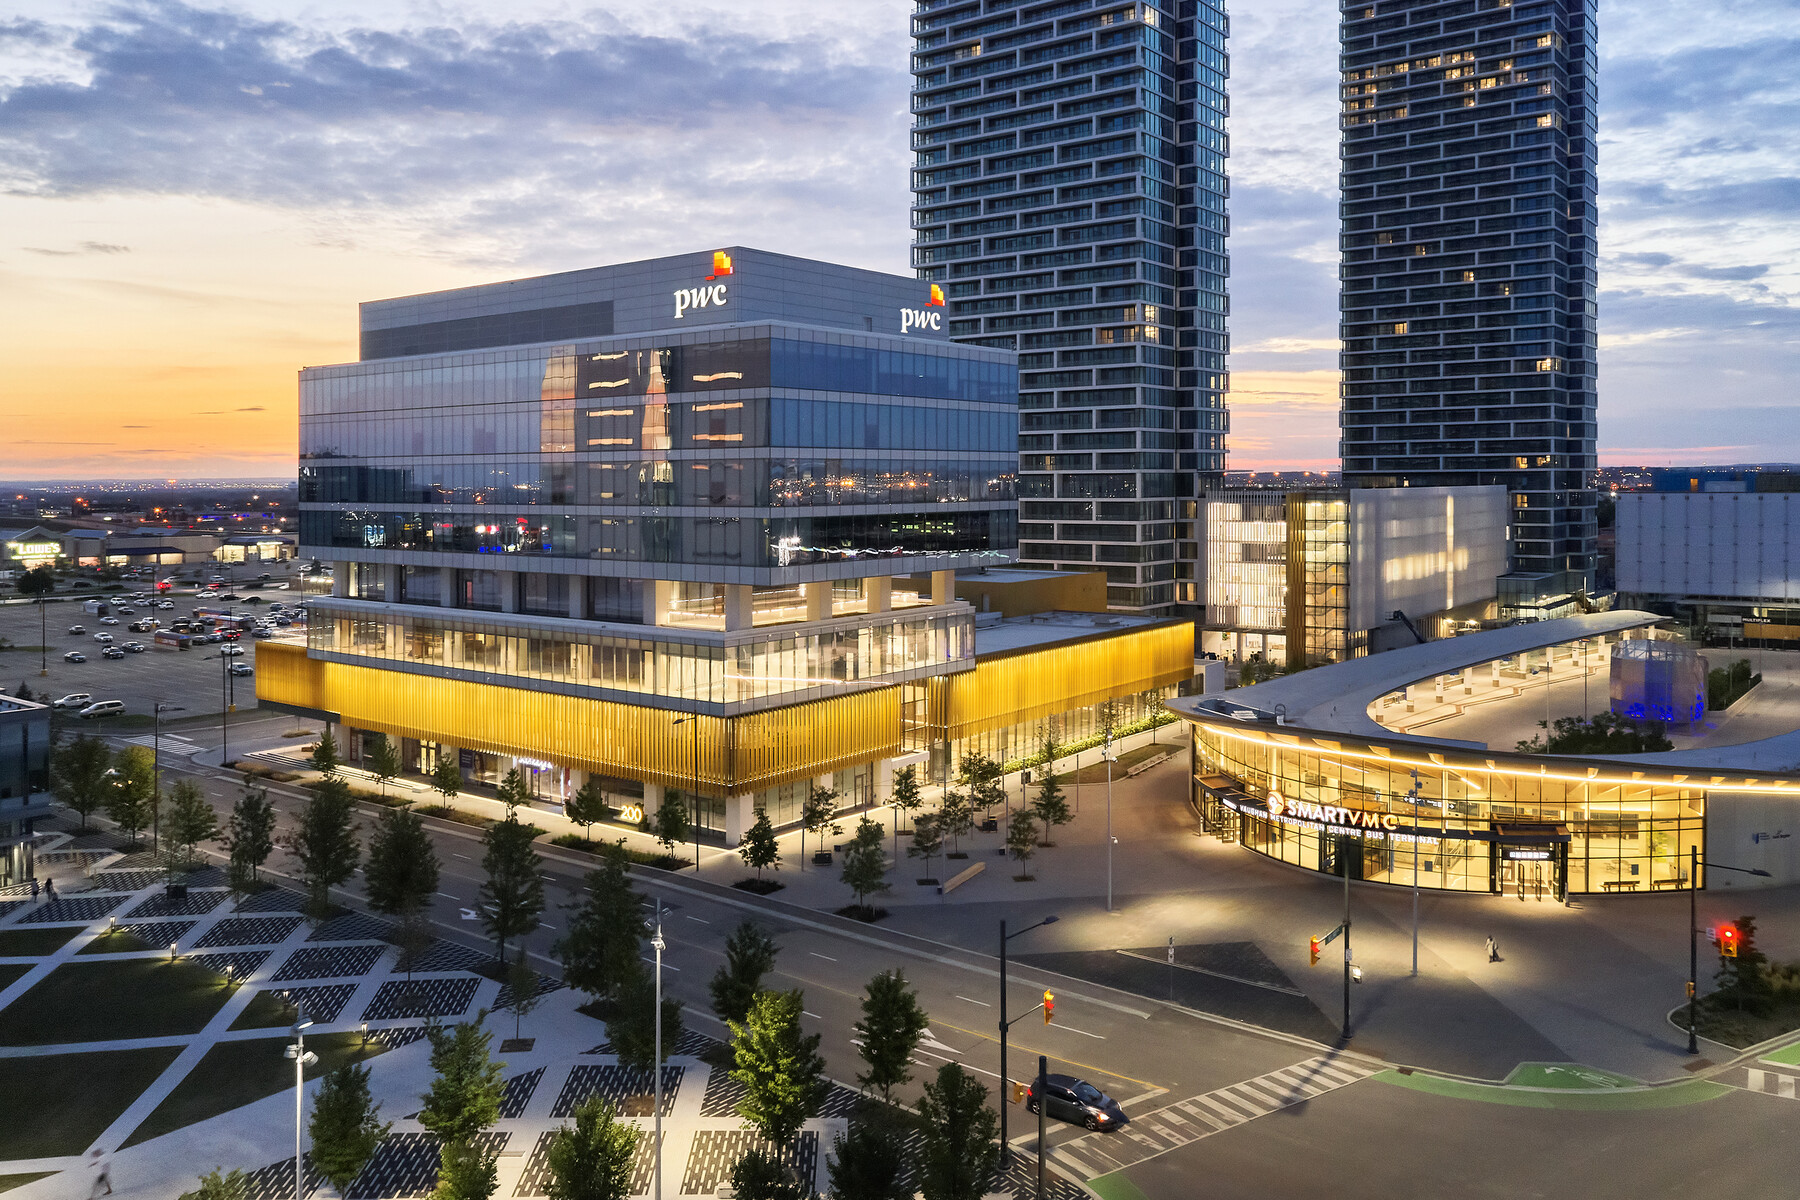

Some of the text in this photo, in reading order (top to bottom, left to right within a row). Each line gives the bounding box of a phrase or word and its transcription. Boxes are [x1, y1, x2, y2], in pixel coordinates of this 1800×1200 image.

[673, 284, 727, 319] pwc
[900, 307, 941, 334] pwc
[18, 543, 61, 554] LOWE'S
[621, 804, 643, 822] 200
[1240, 804, 1268, 819] VAUGHAN
[1269, 814, 1325, 832] METROPOLITAN
[1328, 825, 1362, 837] CENTRE
[1366, 830, 1385, 840] BUS
[1388, 832, 1440, 845] TERMINAL
